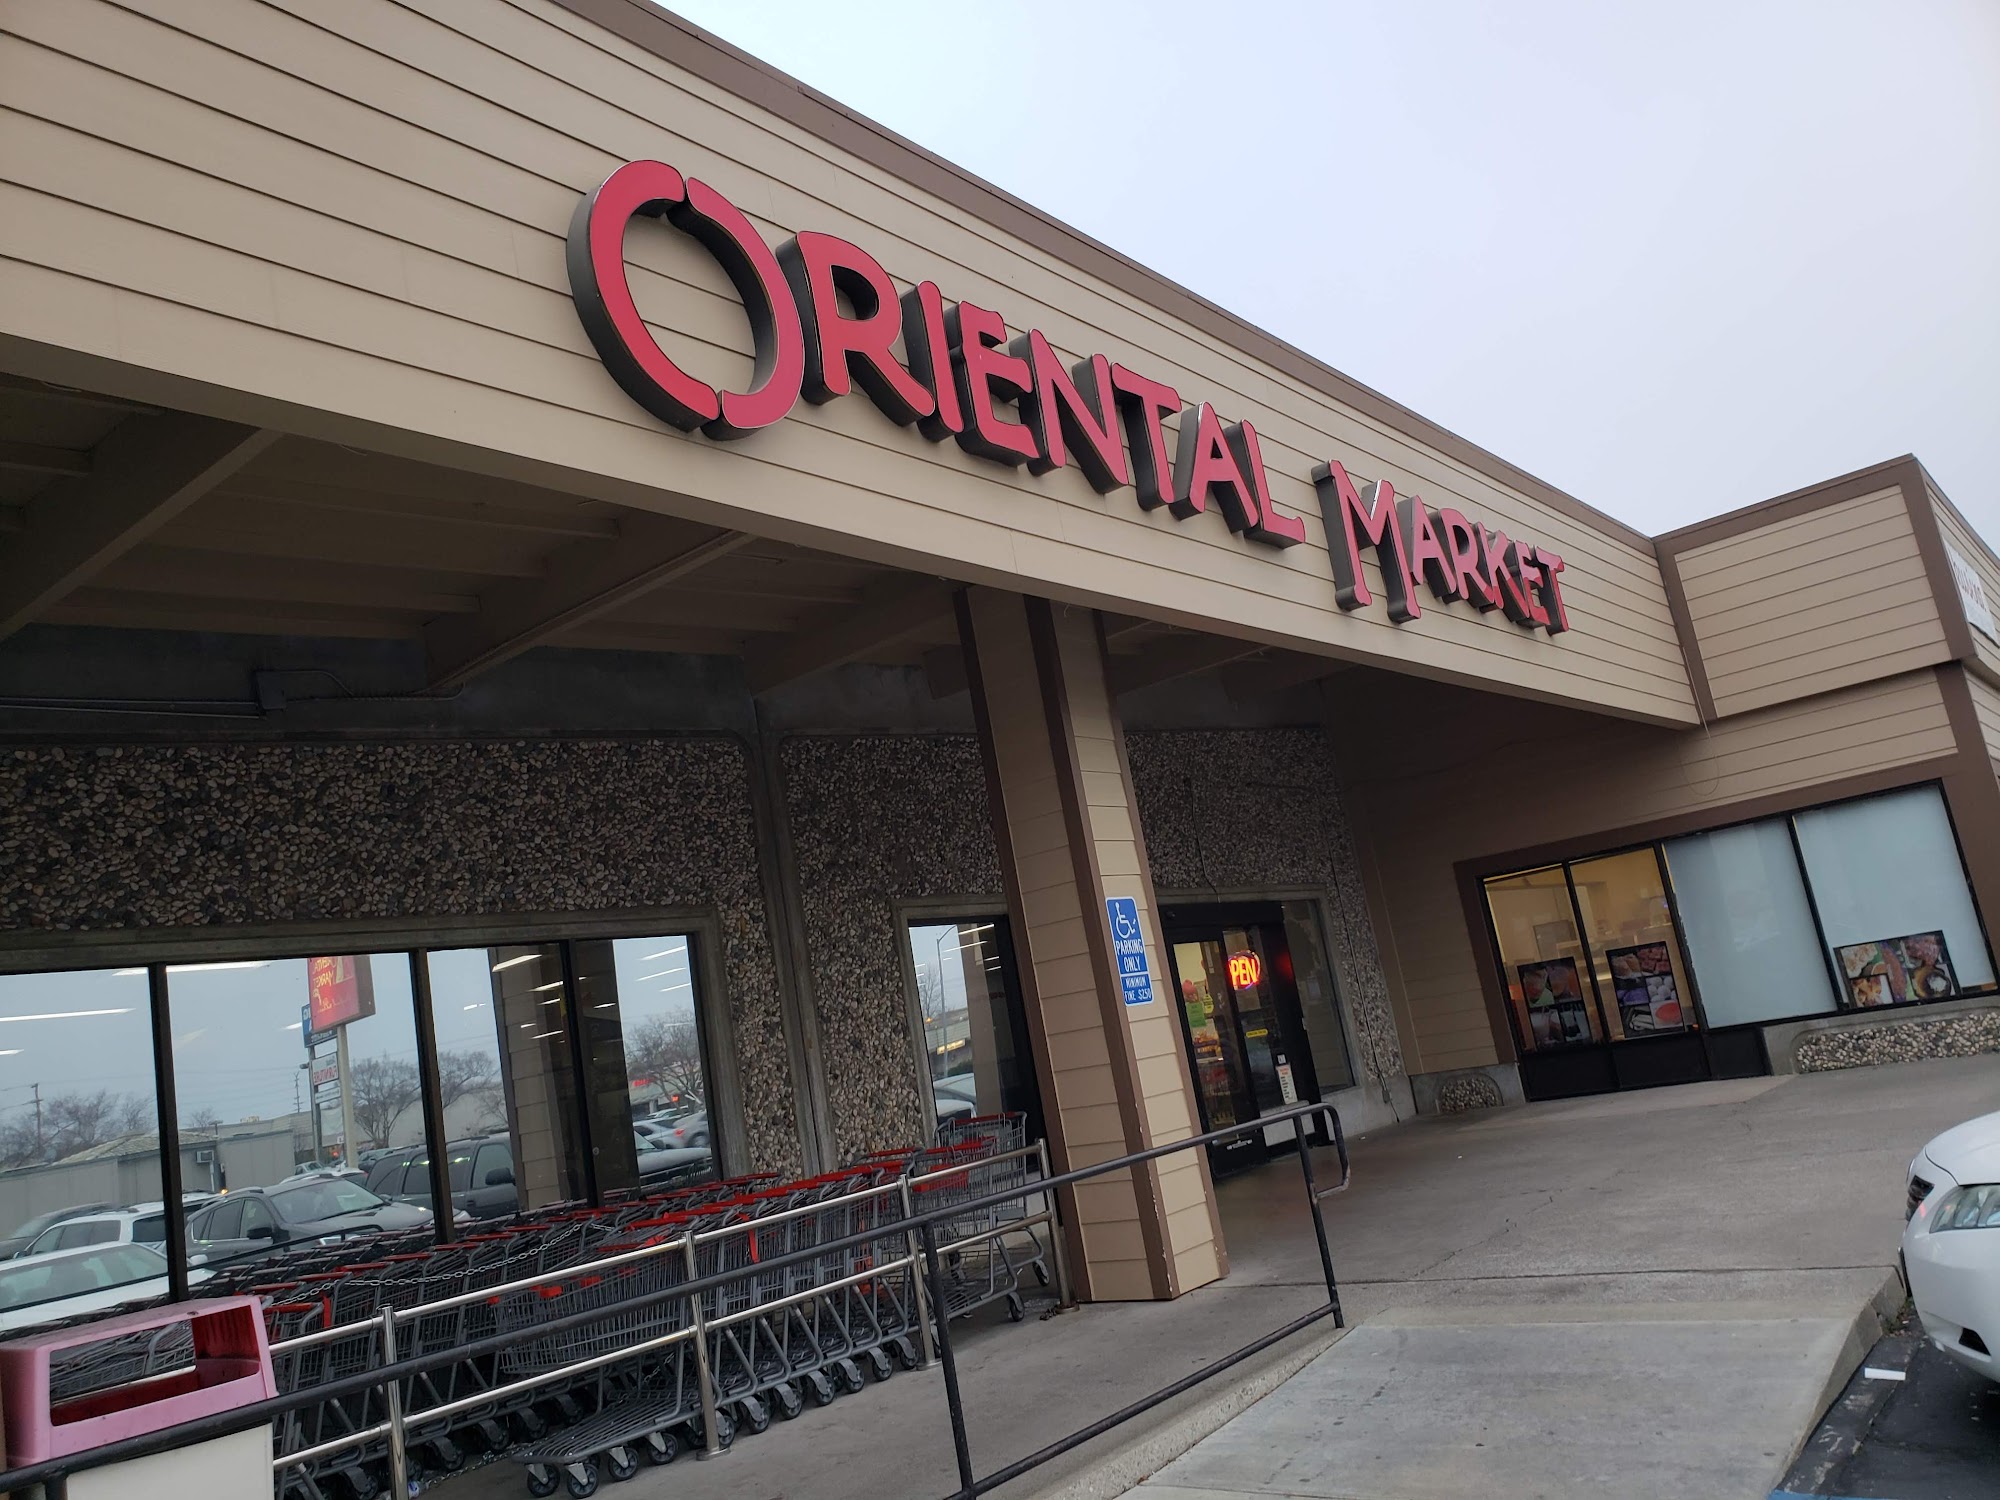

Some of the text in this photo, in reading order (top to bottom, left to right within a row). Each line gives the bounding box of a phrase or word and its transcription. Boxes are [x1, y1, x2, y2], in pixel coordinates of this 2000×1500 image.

[567, 159, 1568, 636] ORIENTAL MARKET
[1115, 939, 1144, 955] PARKING
[1123, 956, 1141, 972] ONLY
[1229, 958, 1257, 986] PEN
[1125, 976, 1147, 987] MINIMUM
[1124, 989, 1152, 1001] FINE $250
